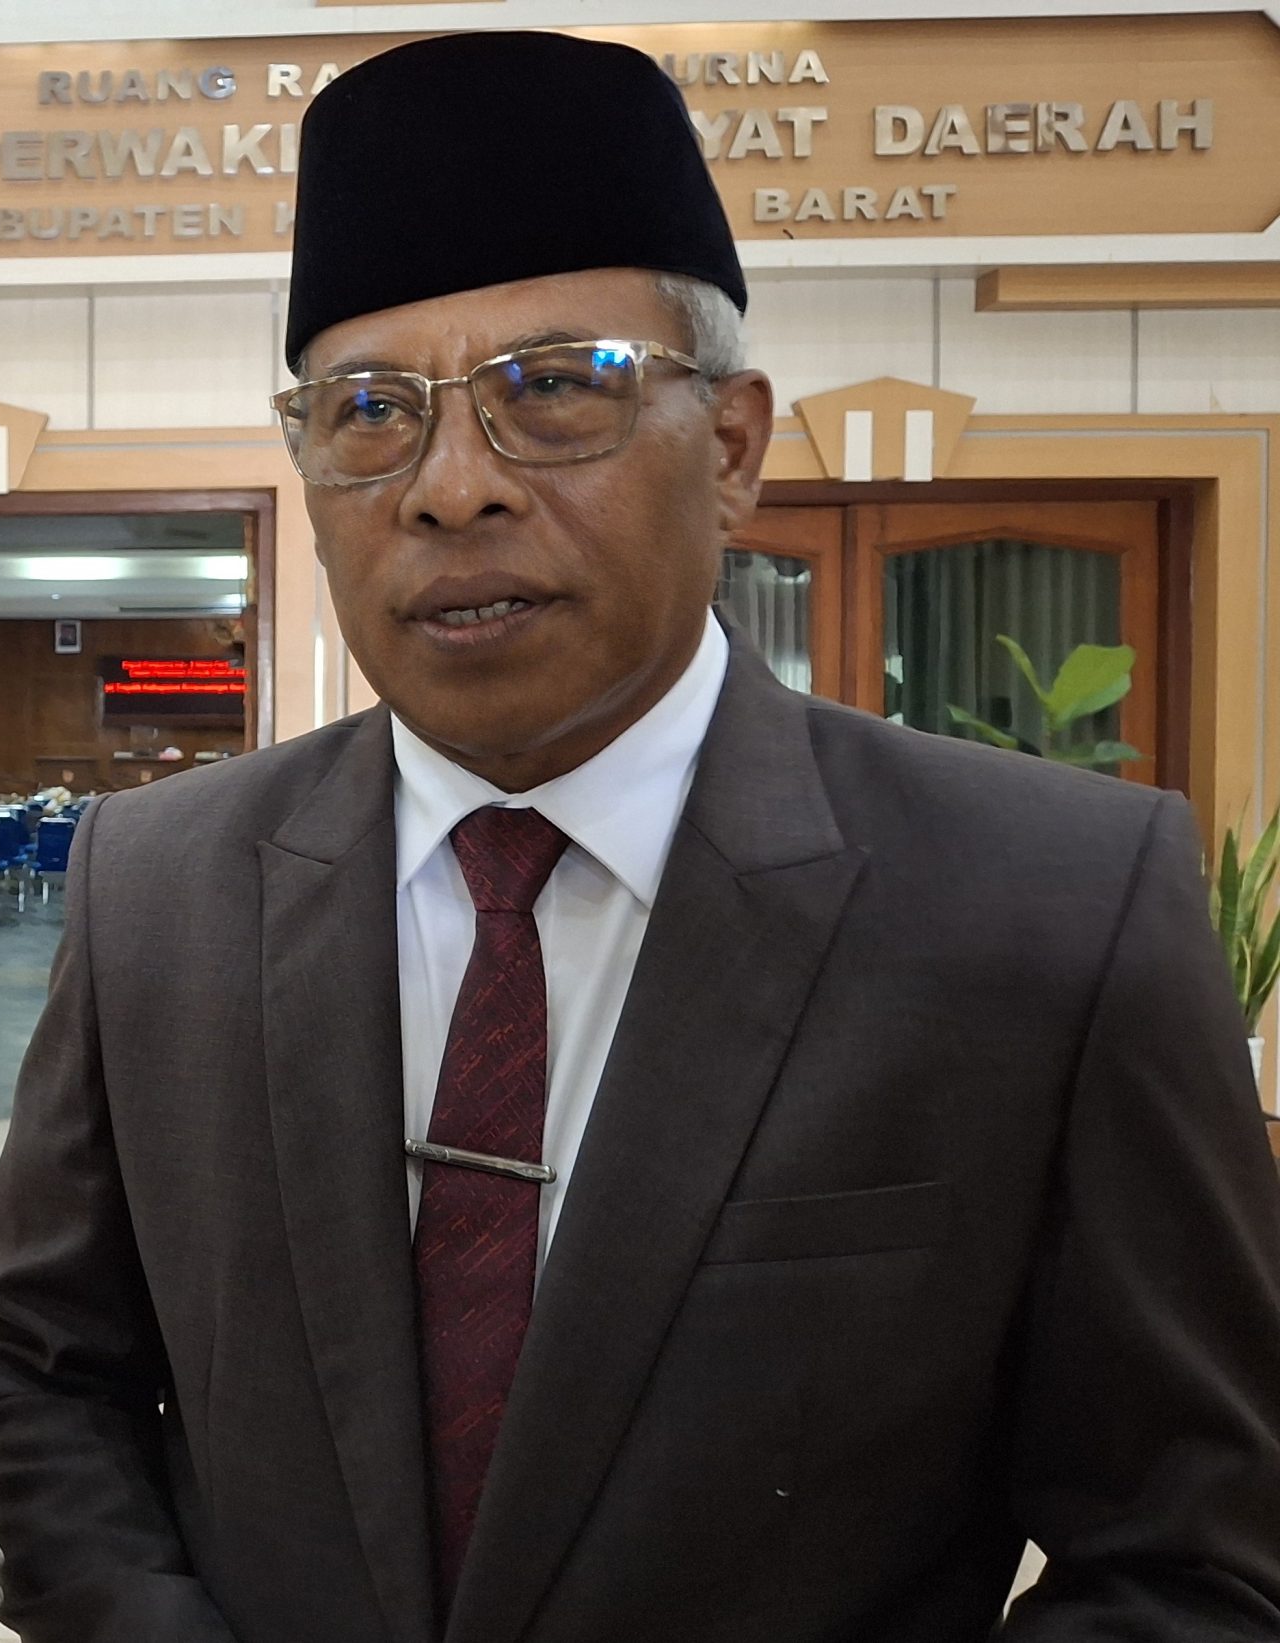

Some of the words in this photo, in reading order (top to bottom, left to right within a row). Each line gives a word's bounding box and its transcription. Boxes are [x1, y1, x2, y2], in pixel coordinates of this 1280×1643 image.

[38, 66, 237, 105] RUANG
[267, 62, 344, 98] RA
[660, 50, 830, 86] URNA
[689, 106, 828, 160] YAT
[873, 100, 1213, 157] DAERAH
[754, 184, 957, 222] BARAT
